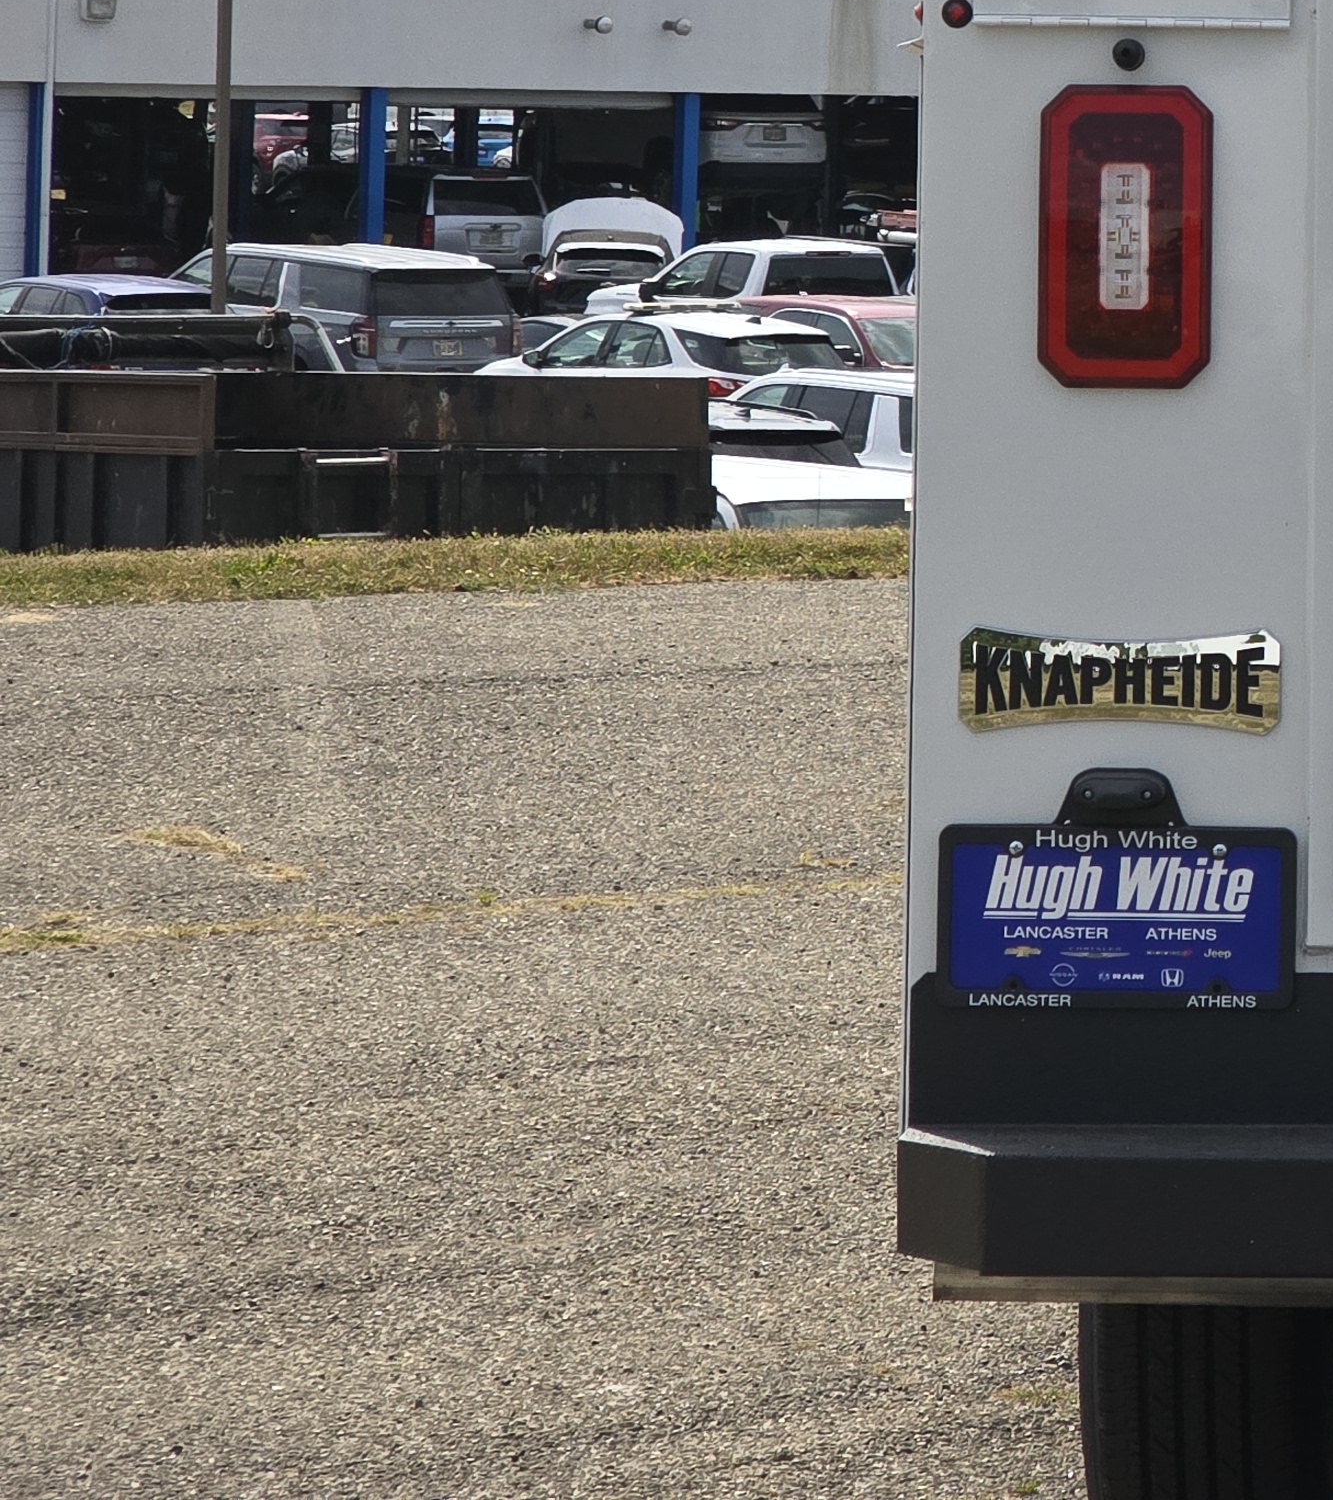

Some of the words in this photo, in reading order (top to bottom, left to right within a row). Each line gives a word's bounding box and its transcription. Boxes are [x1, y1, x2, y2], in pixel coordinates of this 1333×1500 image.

[975, 642, 1265, 718] KNAPHEIDE
[1035, 829, 1108, 852] Hugh
[1118, 830, 1198, 850] White
[985, 854, 1102, 920] Hugh
[1116, 856, 1254, 912] White
[1003, 926, 1109, 940] LANCASTER
[1145, 927, 1217, 941] ATHENS
[1203, 948, 1232, 959] Jeep
[1112, 973, 1145, 981] RAM
[968, 993, 1072, 1007] LANCASTER
[1187, 994, 1257, 1009] ATHENS
